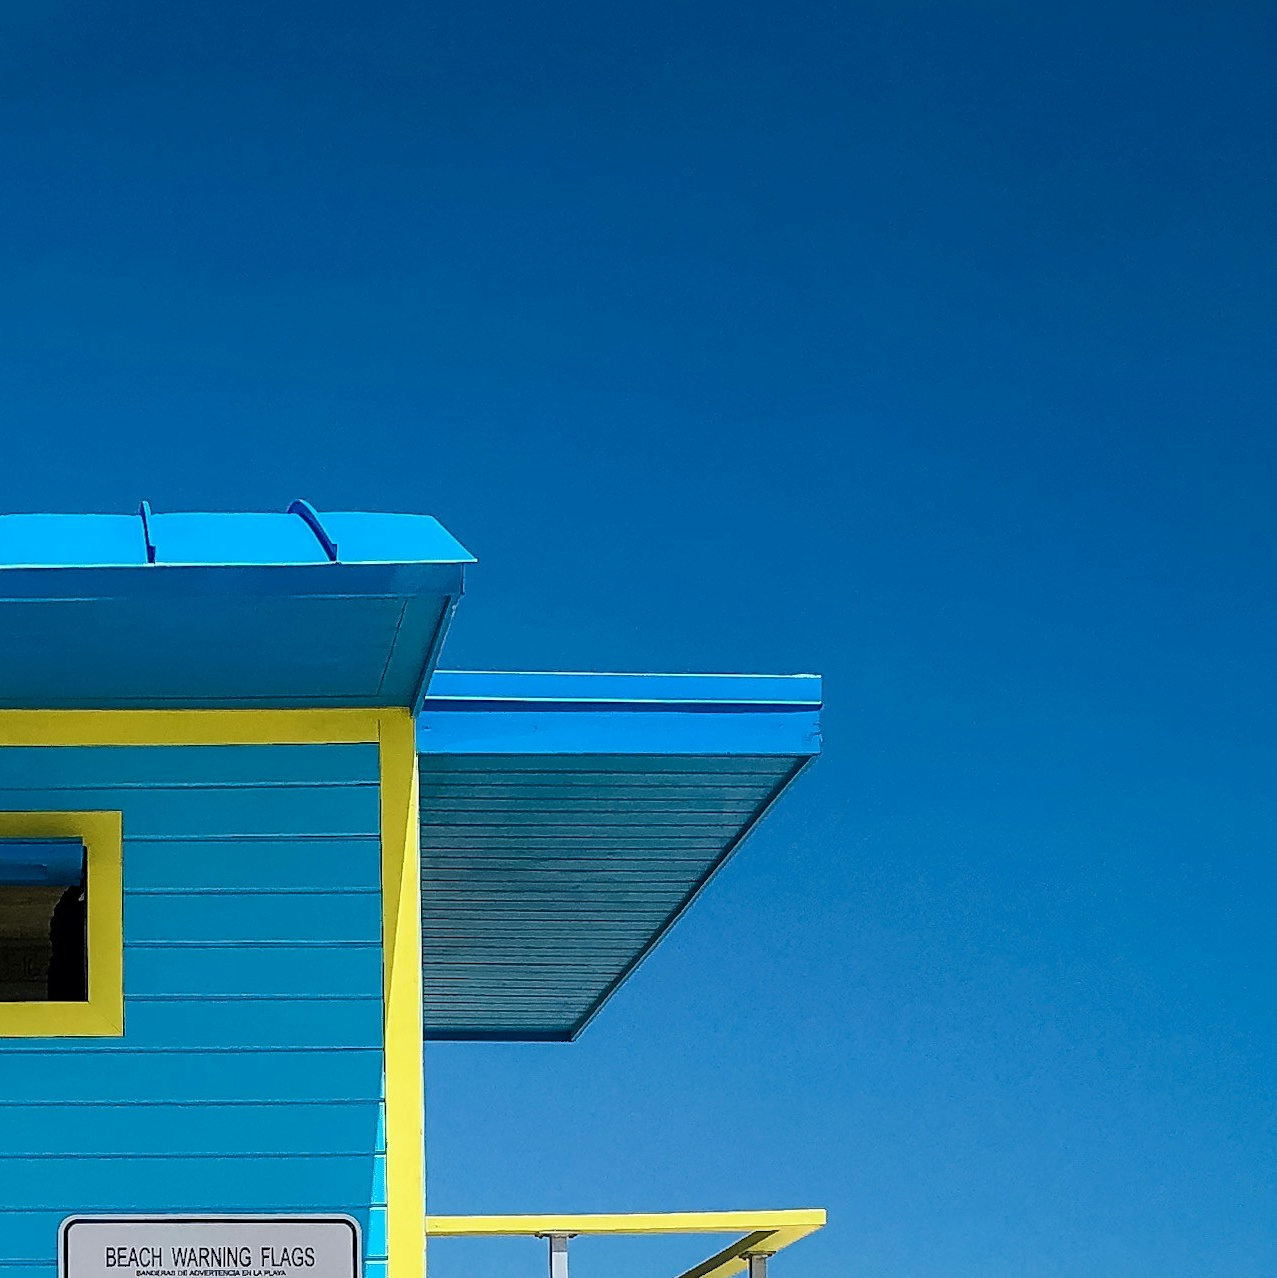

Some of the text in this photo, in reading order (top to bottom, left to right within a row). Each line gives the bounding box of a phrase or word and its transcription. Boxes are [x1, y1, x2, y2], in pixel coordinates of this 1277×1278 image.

[106, 1247, 315, 1267] BEACH WARNING FLAGS
